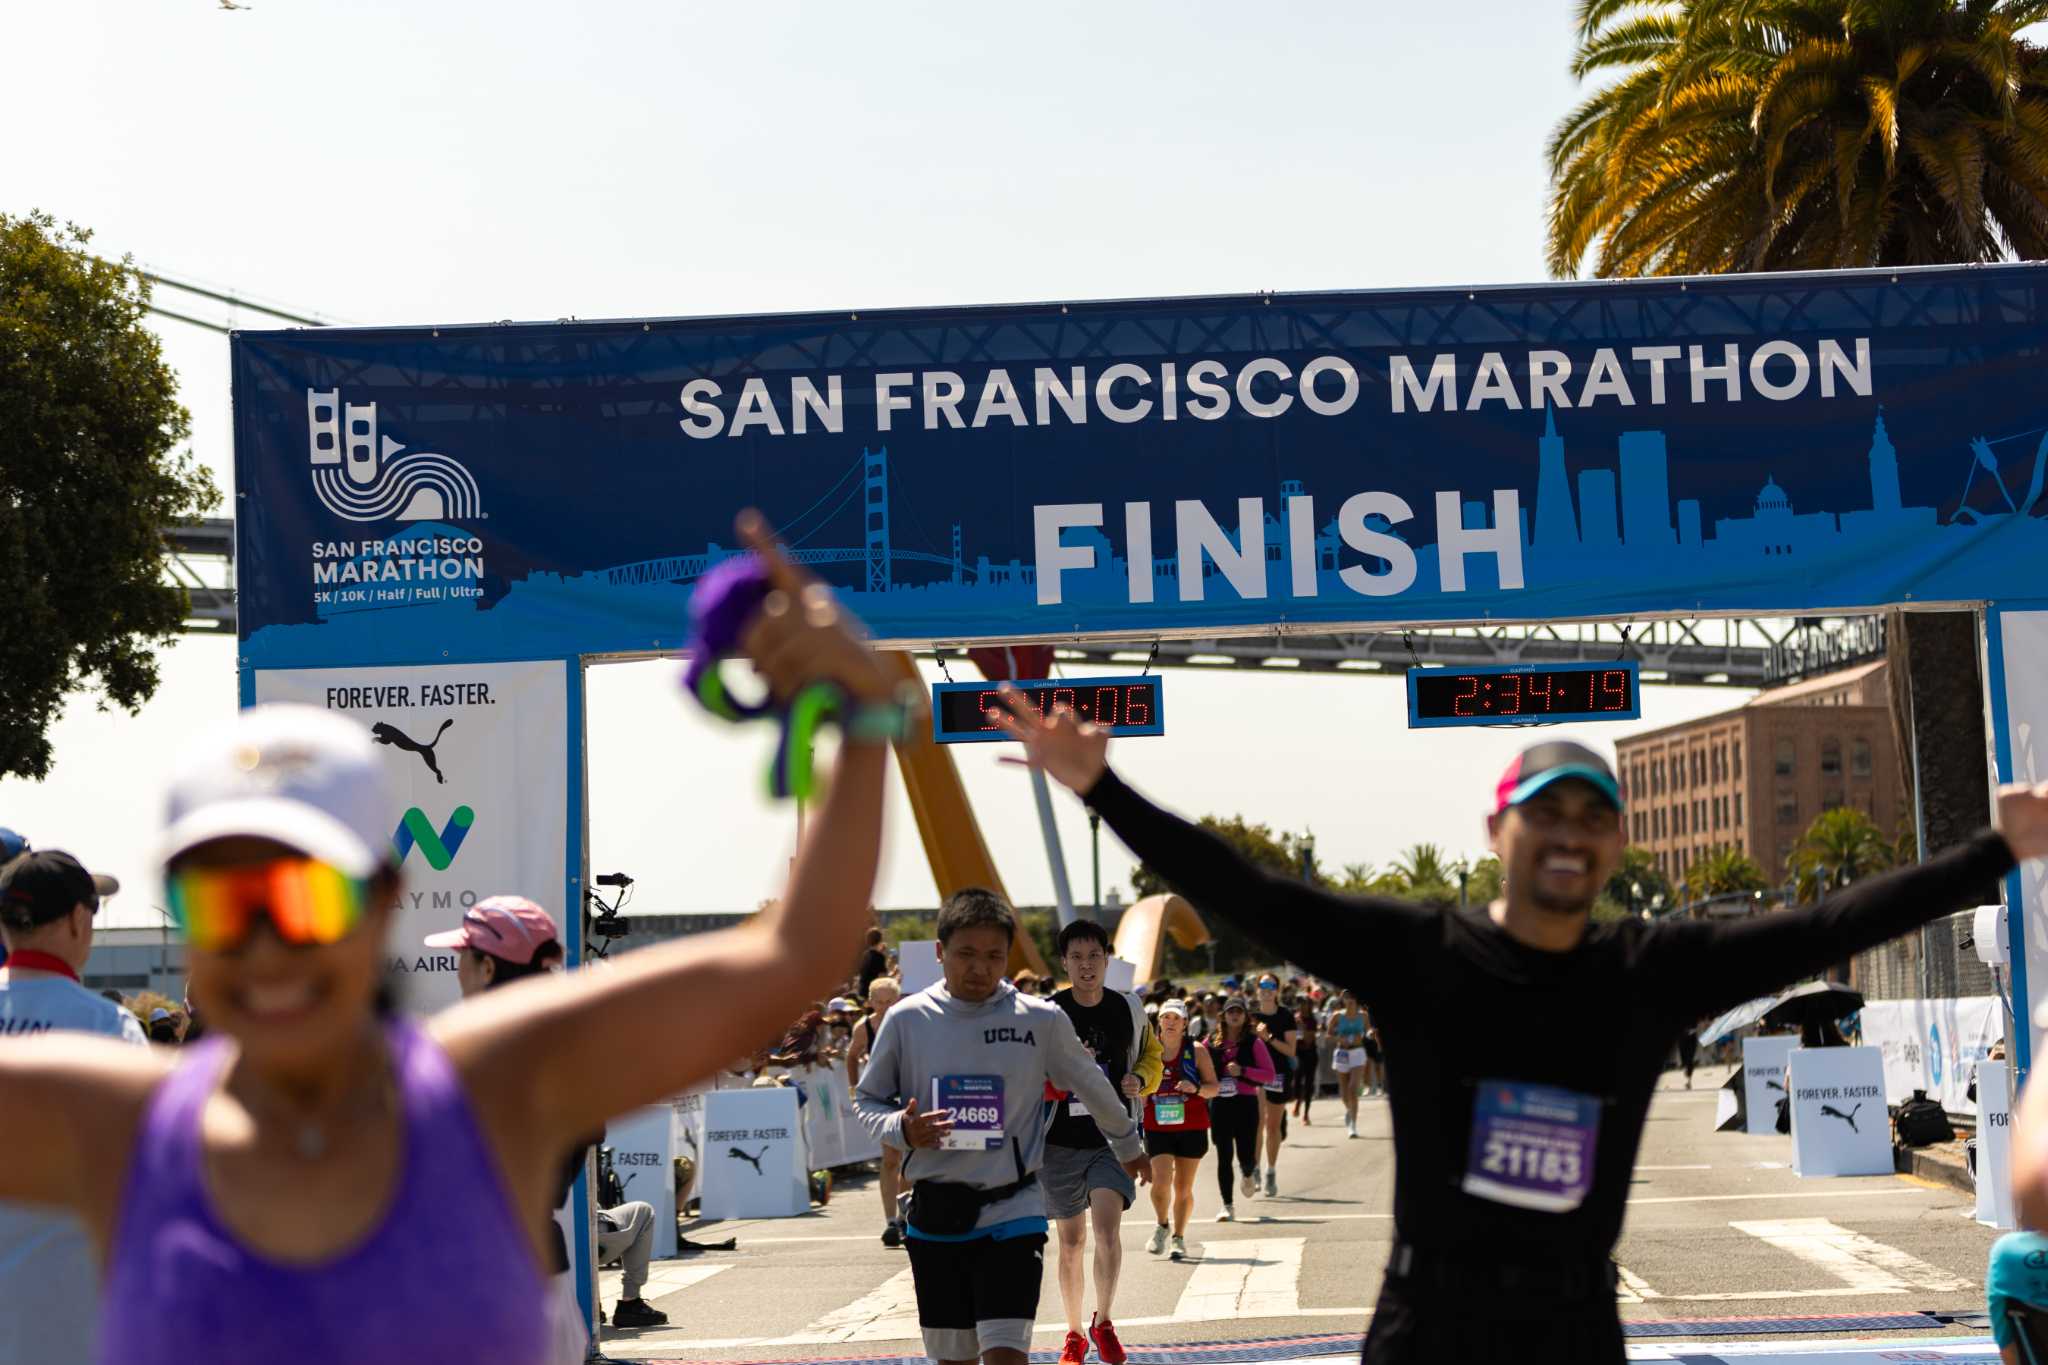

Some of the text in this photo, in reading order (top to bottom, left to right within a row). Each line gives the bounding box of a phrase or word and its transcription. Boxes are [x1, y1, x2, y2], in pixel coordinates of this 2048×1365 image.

[679, 337, 1873, 439] SAN FRANCISCO MARATHON
[312, 537, 483, 558] SAN FRANCISCO
[1033, 489, 1525, 606] FINISH
[313, 557, 484, 584] MARATHON
[314, 592, 332, 603] 5K
[341, 590, 366, 602] 10K
[377, 588, 405, 600] Half
[415, 587, 441, 599] Full
[450, 586, 484, 598] Ultra
[327, 683, 496, 709] FOREVER. FASTER.
[388, 889, 477, 910] AYMO
[414, 955, 460, 972] AIRL
[984, 1028, 1036, 1046] UCLA
[1797, 1086, 1882, 1100] FOREVER. FASTER.
[947, 1107, 999, 1123] 24669
[707, 1128, 790, 1142] FOREVER. FASTER.
[618, 1152, 662, 1167] FASTER.
